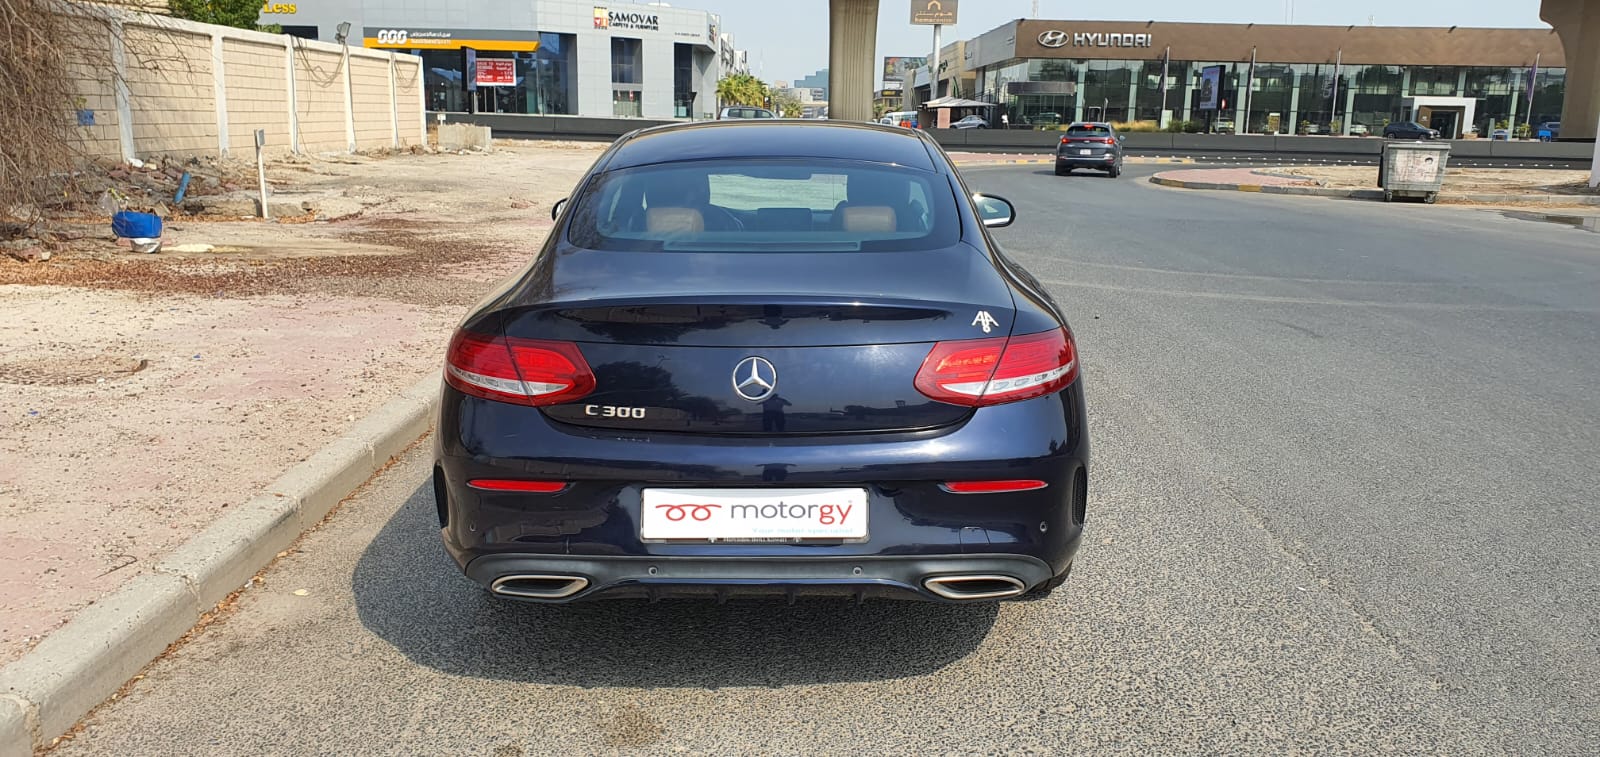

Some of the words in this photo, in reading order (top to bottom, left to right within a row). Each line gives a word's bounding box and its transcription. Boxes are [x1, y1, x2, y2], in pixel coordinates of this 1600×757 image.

[263, 0, 297, 14] Less
[608, 11, 659, 25] SAMOVAR
[1073, 32, 1152, 47] HYUNDAI
[585, 404, 599, 416] C
[602, 406, 646, 419] 300
[730, 501, 853, 525] motorgy
